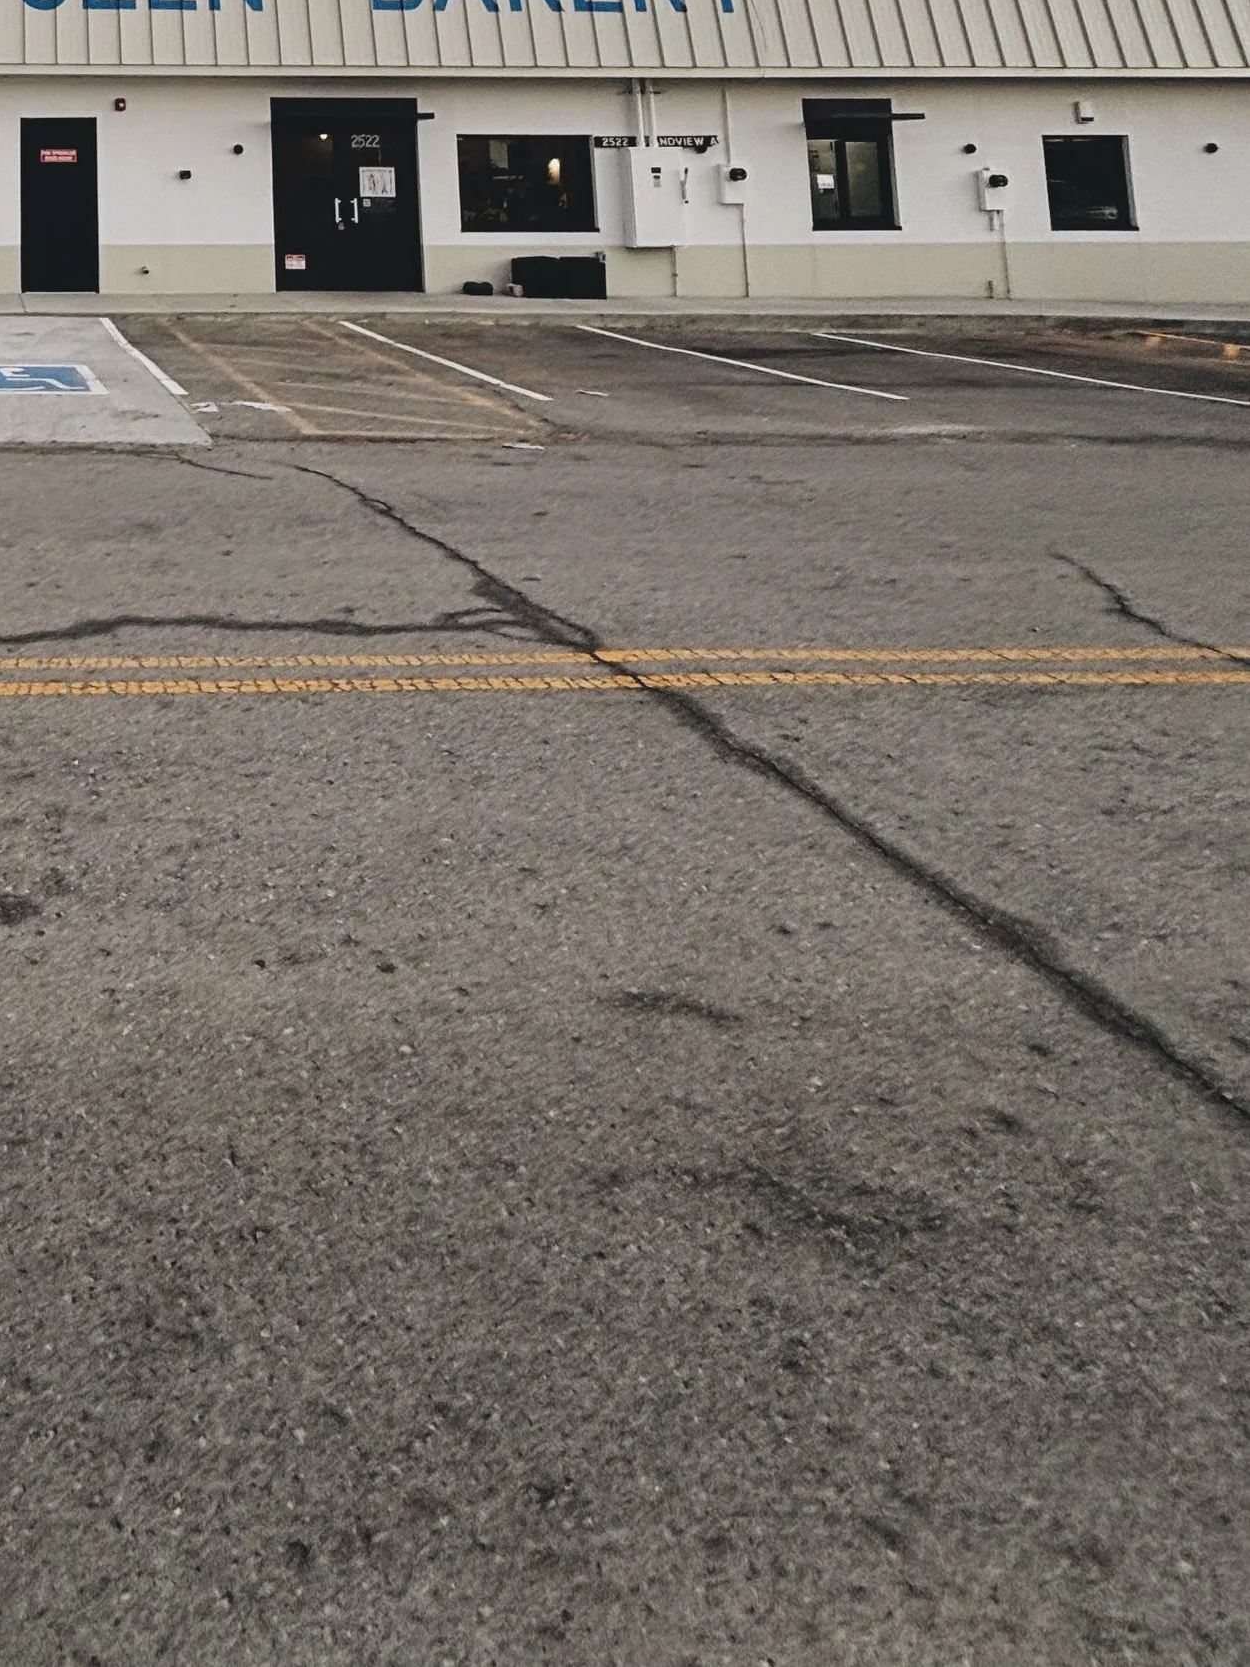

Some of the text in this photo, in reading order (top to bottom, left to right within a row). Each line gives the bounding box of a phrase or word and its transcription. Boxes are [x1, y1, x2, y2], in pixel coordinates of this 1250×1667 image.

[351, 134, 380, 148] 2522
[601, 137, 630, 147] 2522
[658, 136, 705, 147] NDVIEW
